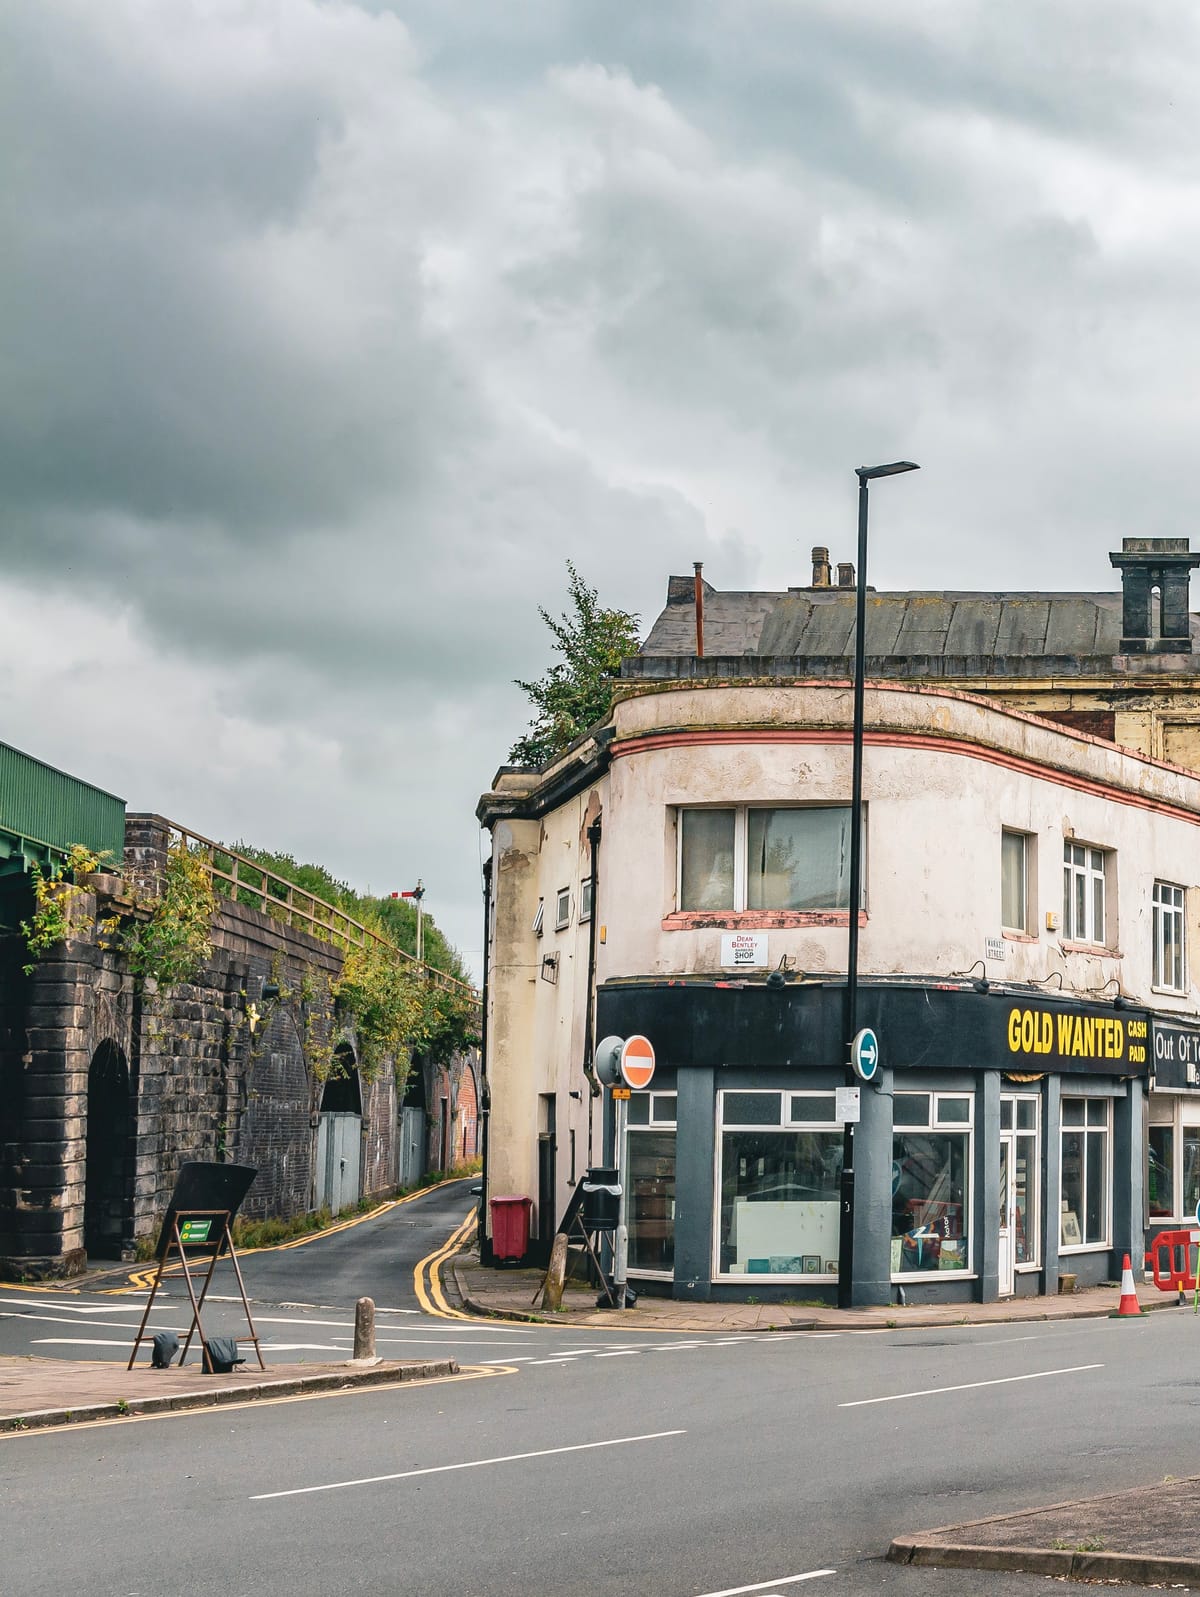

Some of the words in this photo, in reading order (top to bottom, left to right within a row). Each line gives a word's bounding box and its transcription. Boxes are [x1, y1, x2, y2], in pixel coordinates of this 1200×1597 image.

[1008, 1008, 1054, 1054] GOLD
[1057, 1013, 1124, 1059] WANTED
[1127, 1020, 1147, 1038] CASH
[1128, 1045, 1146, 1063] PAID
[1156, 1031, 1175, 1061] Out
[1178, 1034, 1191, 1062] Of
